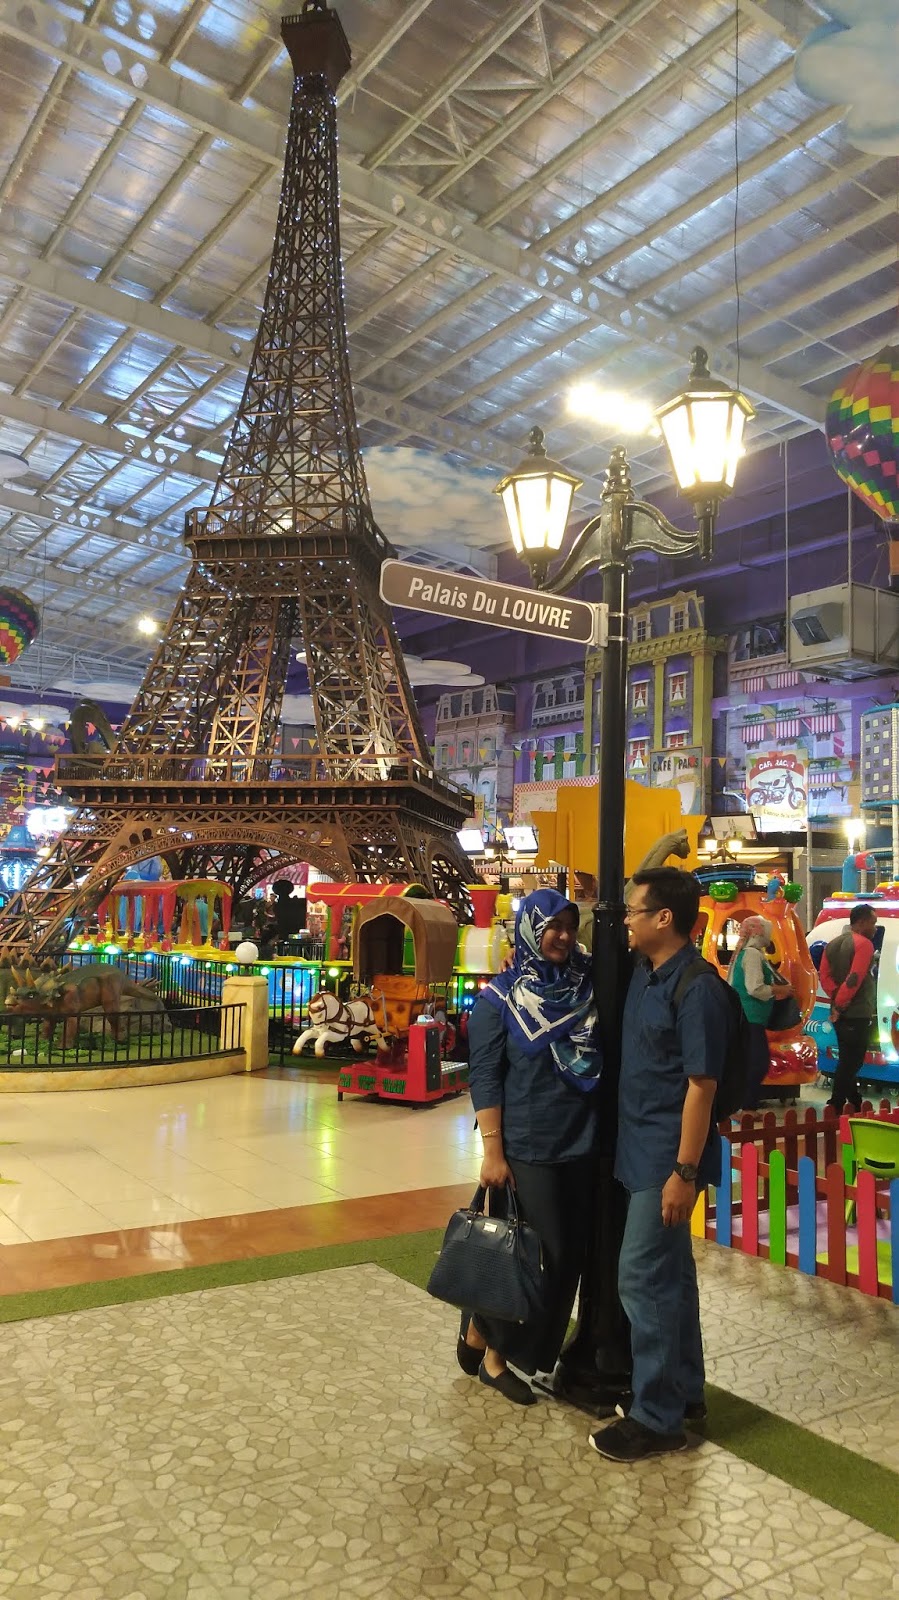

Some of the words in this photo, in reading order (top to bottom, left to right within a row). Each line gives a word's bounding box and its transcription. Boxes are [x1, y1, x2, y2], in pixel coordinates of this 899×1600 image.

[408, 577, 467, 609] Palais
[472, 592, 497, 614] Du
[501, 597, 572, 630] LOUVRE
[678, 757, 699, 770] PAS
